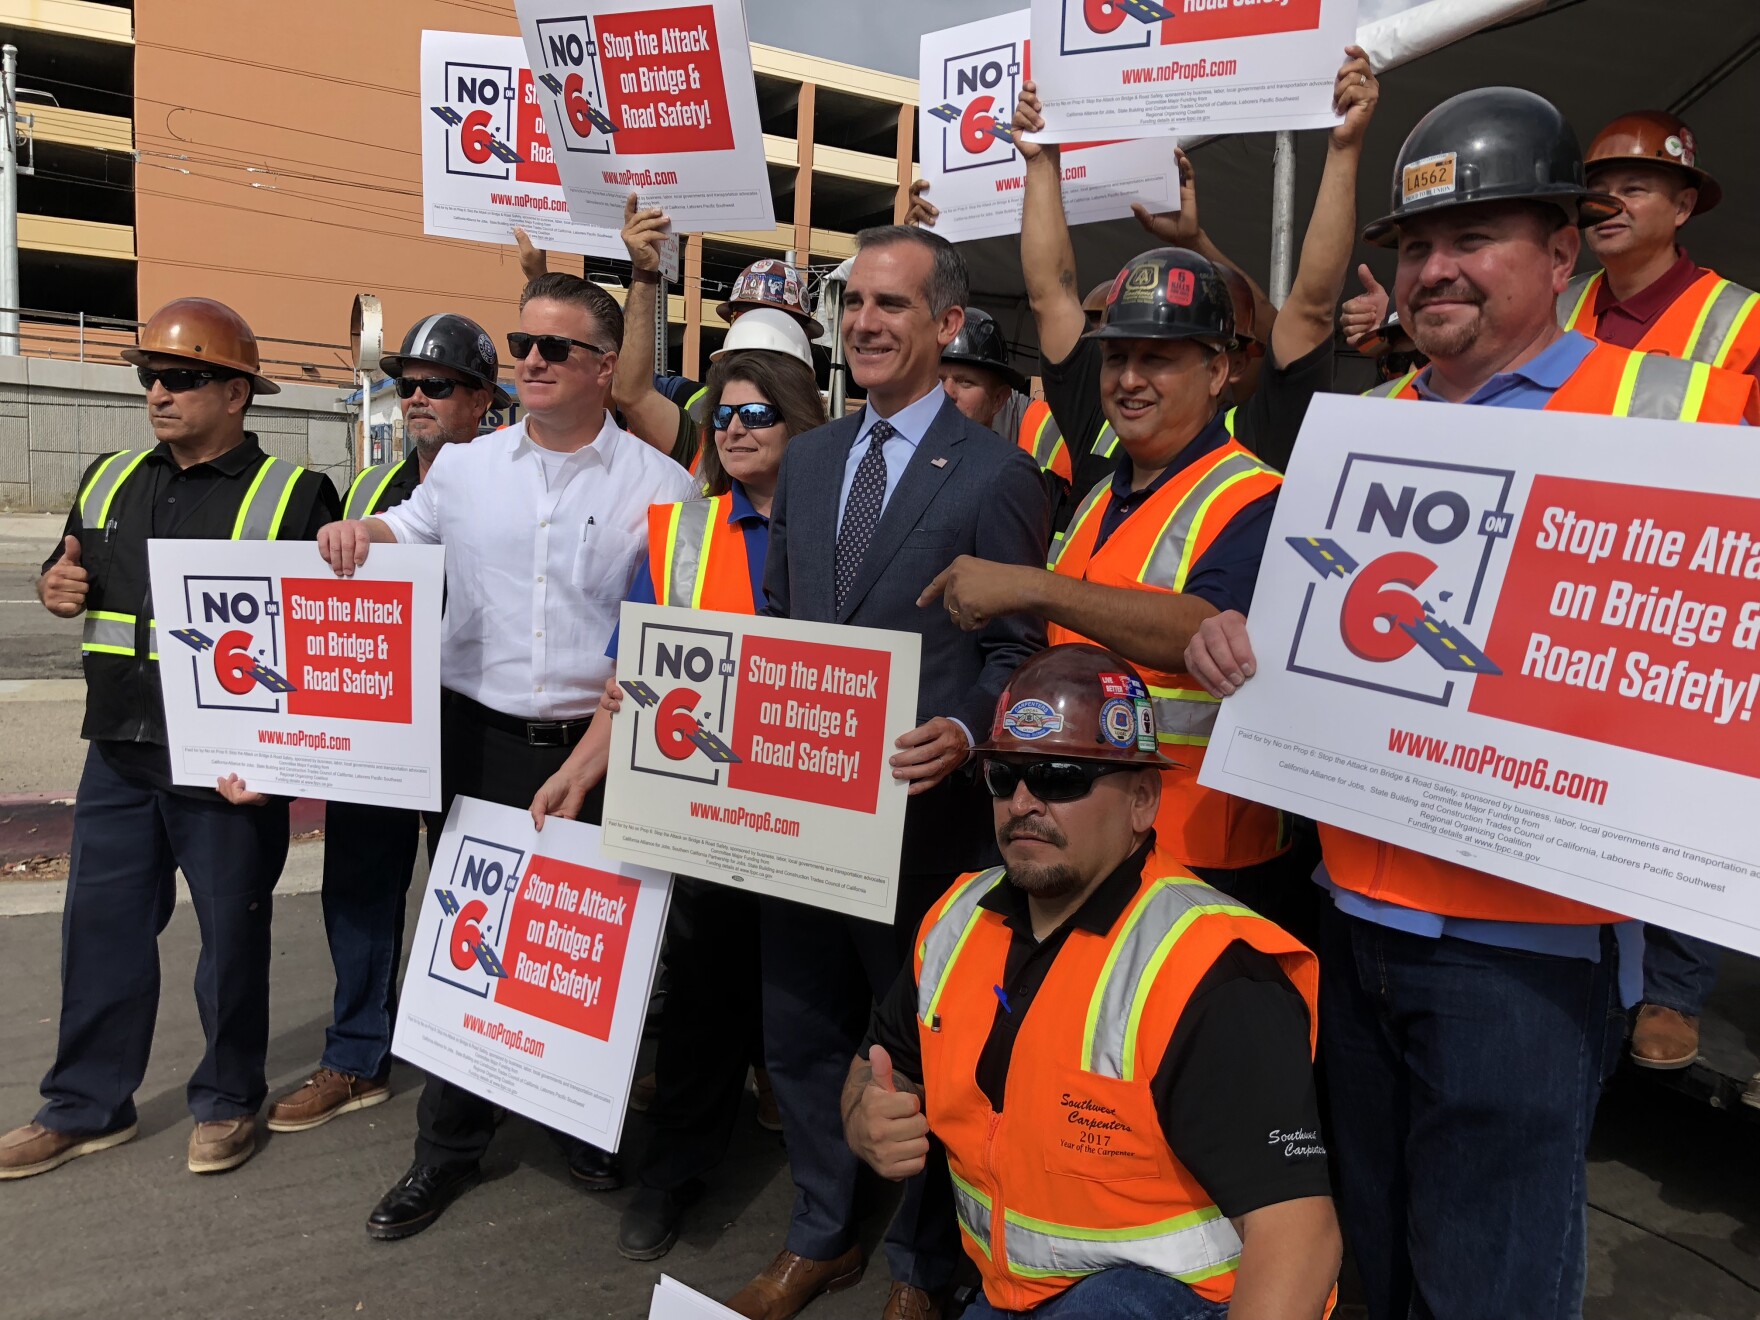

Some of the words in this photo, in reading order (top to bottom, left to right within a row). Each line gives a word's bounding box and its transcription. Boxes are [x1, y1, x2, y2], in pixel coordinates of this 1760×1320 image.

[548, 33, 584, 67] NO
[602, 32, 634, 61] Stop
[635, 29, 659, 55] the
[661, 25, 710, 54] Attack
[457, 77, 500, 105] NO
[505, 89, 514, 98] ON
[620, 70, 639, 92] on
[640, 64, 687, 95] Bridge
[689, 63, 701, 89] &
[957, 61, 1003, 95] NO
[1009, 65, 1018, 74] ON
[1122, 59, 1237, 84] www.noProp6.com
[563, 72, 592, 138] 6
[620, 103, 657, 129] Road
[659, 100, 712, 132] Safety!
[960, 95, 996, 155] 6
[460, 109, 494, 164] 6
[530, 142, 556, 164] Roa
[602, 169, 678, 190] www.noProp6.com
[1408, 168, 1447, 191] LA562
[1356, 481, 1471, 545] NO
[1485, 515, 1507, 534] ON
[1535, 506, 1618, 564] Stop
[1622, 518, 1686, 568] the
[202, 591, 260, 624] NO
[267, 603, 278, 614] ON
[291, 595, 325, 624] Stop
[327, 597, 350, 622] the
[354, 598, 403, 625] Attack
[1339, 551, 1439, 663] 6
[1550, 580, 1597, 621] on
[1600, 580, 1727, 647] Bridge
[1732, 601, 1760, 650] &
[213, 630, 258, 695] 6
[307, 634, 325, 655] on
[328, 632, 374, 662] Bridge
[377, 634, 389, 660] &
[655, 642, 714, 683] NO
[721, 662, 733, 674] ON
[304, 666, 340, 692] Road
[343, 668, 394, 699] Safety!
[748, 655, 787, 691] Stop
[791, 660, 817, 690] the
[820, 664, 879, 699] Attack
[1520, 632, 1617, 691] Road
[1619, 651, 1760, 725] Safety!
[654, 687, 703, 760] 6
[760, 702, 782, 726] on
[785, 700, 841, 738] Bridge
[845, 709, 858, 737] &
[258, 729, 351, 751] www.noProp6.com
[750, 735, 795, 768] Road
[798, 742, 860, 783] Safety!
[1387, 727, 1609, 806] www.noProp6.com
[690, 801, 801, 837] www.noProp6.com
[1238, 730, 1253, 740] Paid
[1254, 734, 1262, 742] for
[1263, 737, 1272, 746] by
[1272, 740, 1282, 748] No
[1293, 745, 1309, 756] Prop
[1318, 752, 1333, 763] Stop
[1334, 756, 1345, 766] the
[1346, 759, 1368, 772] Attack
[1369, 766, 1379, 774] on
[1380, 768, 1403, 781] Bridge
[1412, 777, 1432, 789] Road
[1461, 791, 1501, 808] sponsored
[1502, 801, 1512, 812] by
[1514, 803, 1552, 822] business,
[1554, 816, 1577, 829] labor,
[1579, 823, 1601, 835] local
[1601, 830, 1660, 851] governments
[1662, 845, 1680, 856] and
[1682, 850, 1748, 875] transportation
[1422, 790, 1463, 808] Committee
[1464, 802, 1486, 815] Major
[1488, 808, 1520, 825] Funding
[1521, 817, 1540, 829] from
[1279, 760, 1309, 775] California
[1310, 769, 1336, 783] Alliance
[1337, 776, 1347, 785] for
[1369, 786, 1389, 798] State
[1390, 791, 1419, 807] Building
[1420, 801, 1435, 810] and
[1436, 804, 1483, 824] Construction
[1486, 818, 1512, 832] Trades
[1513, 826, 1545, 841] Council
[1545, 836, 1556, 844] of
[1556, 839, 1598, 858] California,
[1601, 851, 1641, 869] Laborers
[1643, 862, 1674, 878] Pacific
[1675, 872, 1726, 893] Southwest
[1407, 817, 1437, 834] Funding
[1439, 827, 1463, 840] details
[1474, 837, 1541, 862] www.fppc.ca.gov
[1419, 810, 1453, 826] Regional
[1454, 821, 1496, 839] Organizing
[1497, 832, 1532, 849] Coalition
[461, 854, 504, 895] NO
[523, 873, 555, 910] Stop
[555, 880, 578, 913] the
[578, 887, 627, 926] Attack
[450, 899, 488, 971] 6
[526, 919, 545, 944] on
[545, 919, 591, 962] Bridge
[591, 932, 605, 963] &
[514, 951, 551, 988] Road
[550, 960, 602, 1007] Safety!
[462, 1011, 546, 1059] www.noProp6.com
[1061, 1093, 1116, 1116] Southwest
[1068, 1111, 1132, 1132] Carpenters
[1060, 1138, 1074, 1149] Year
[1076, 1144, 1084, 1153] of
[1085, 1145, 1096, 1154] the
[1097, 1147, 1135, 1157] Carpenter
[1080, 1131, 1111, 1146] 2017
